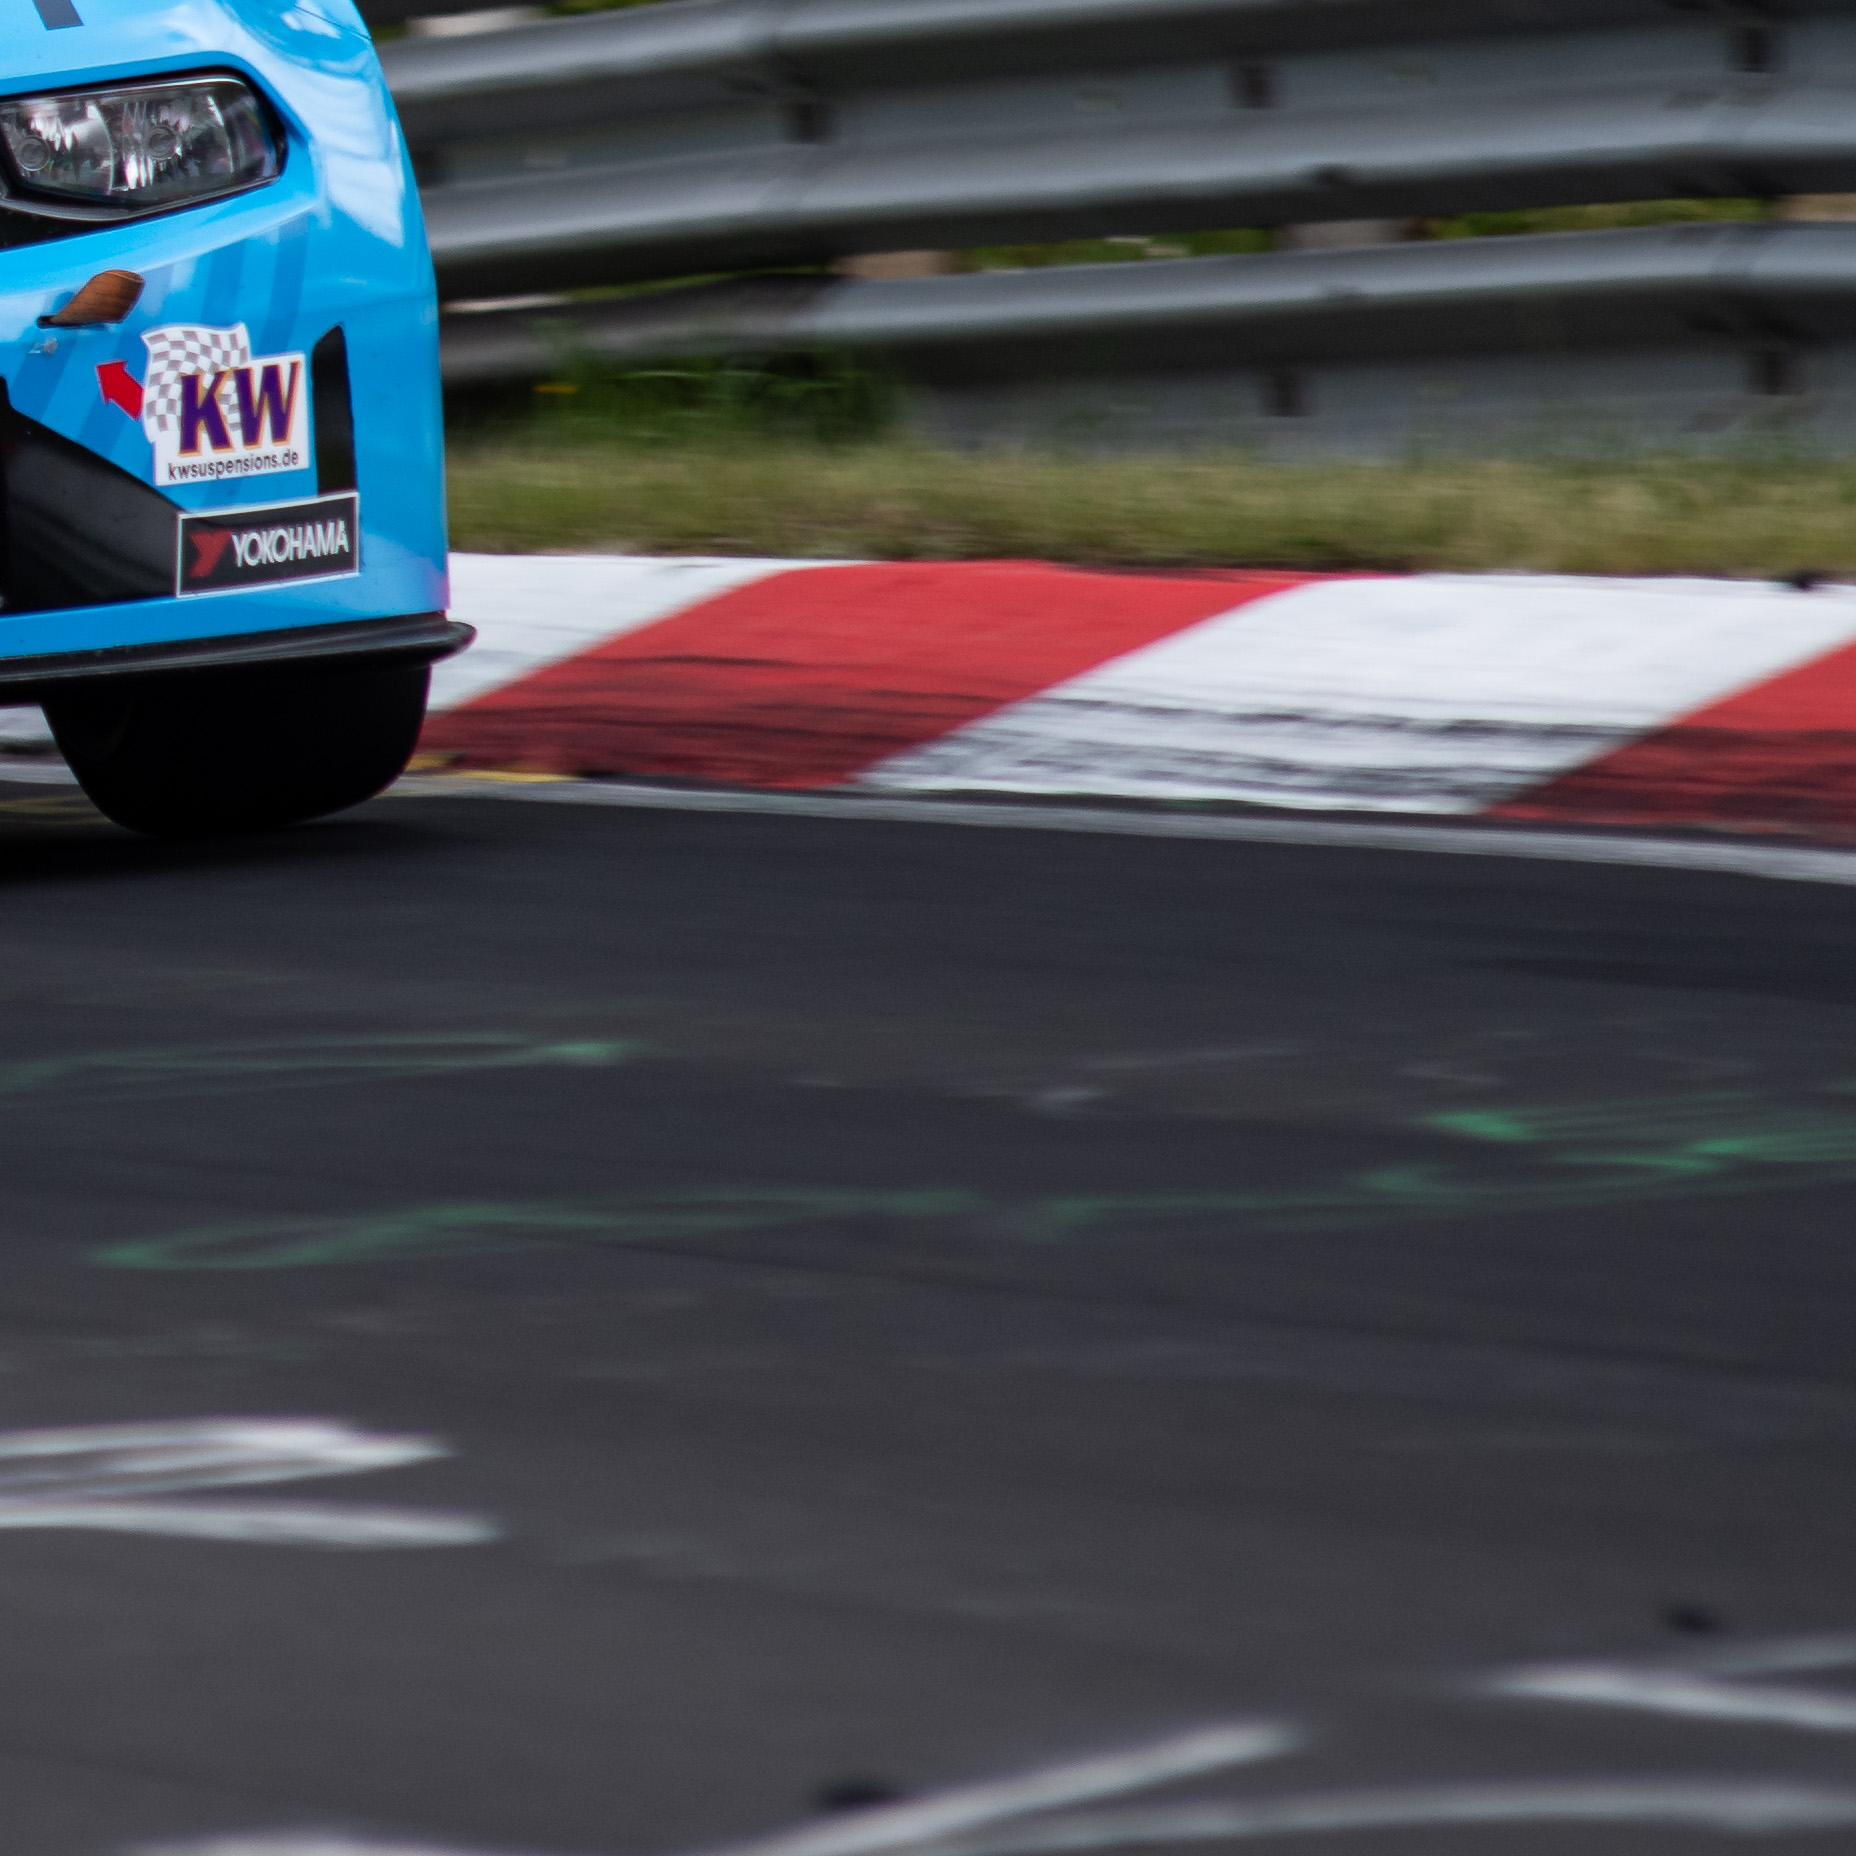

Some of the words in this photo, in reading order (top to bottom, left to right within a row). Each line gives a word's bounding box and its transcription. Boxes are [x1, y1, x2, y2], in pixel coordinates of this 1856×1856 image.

[178, 359, 302, 458] KW
[167, 451, 300, 482] kwsuspensions.de
[231, 519, 350, 568] YOKOHAMA
